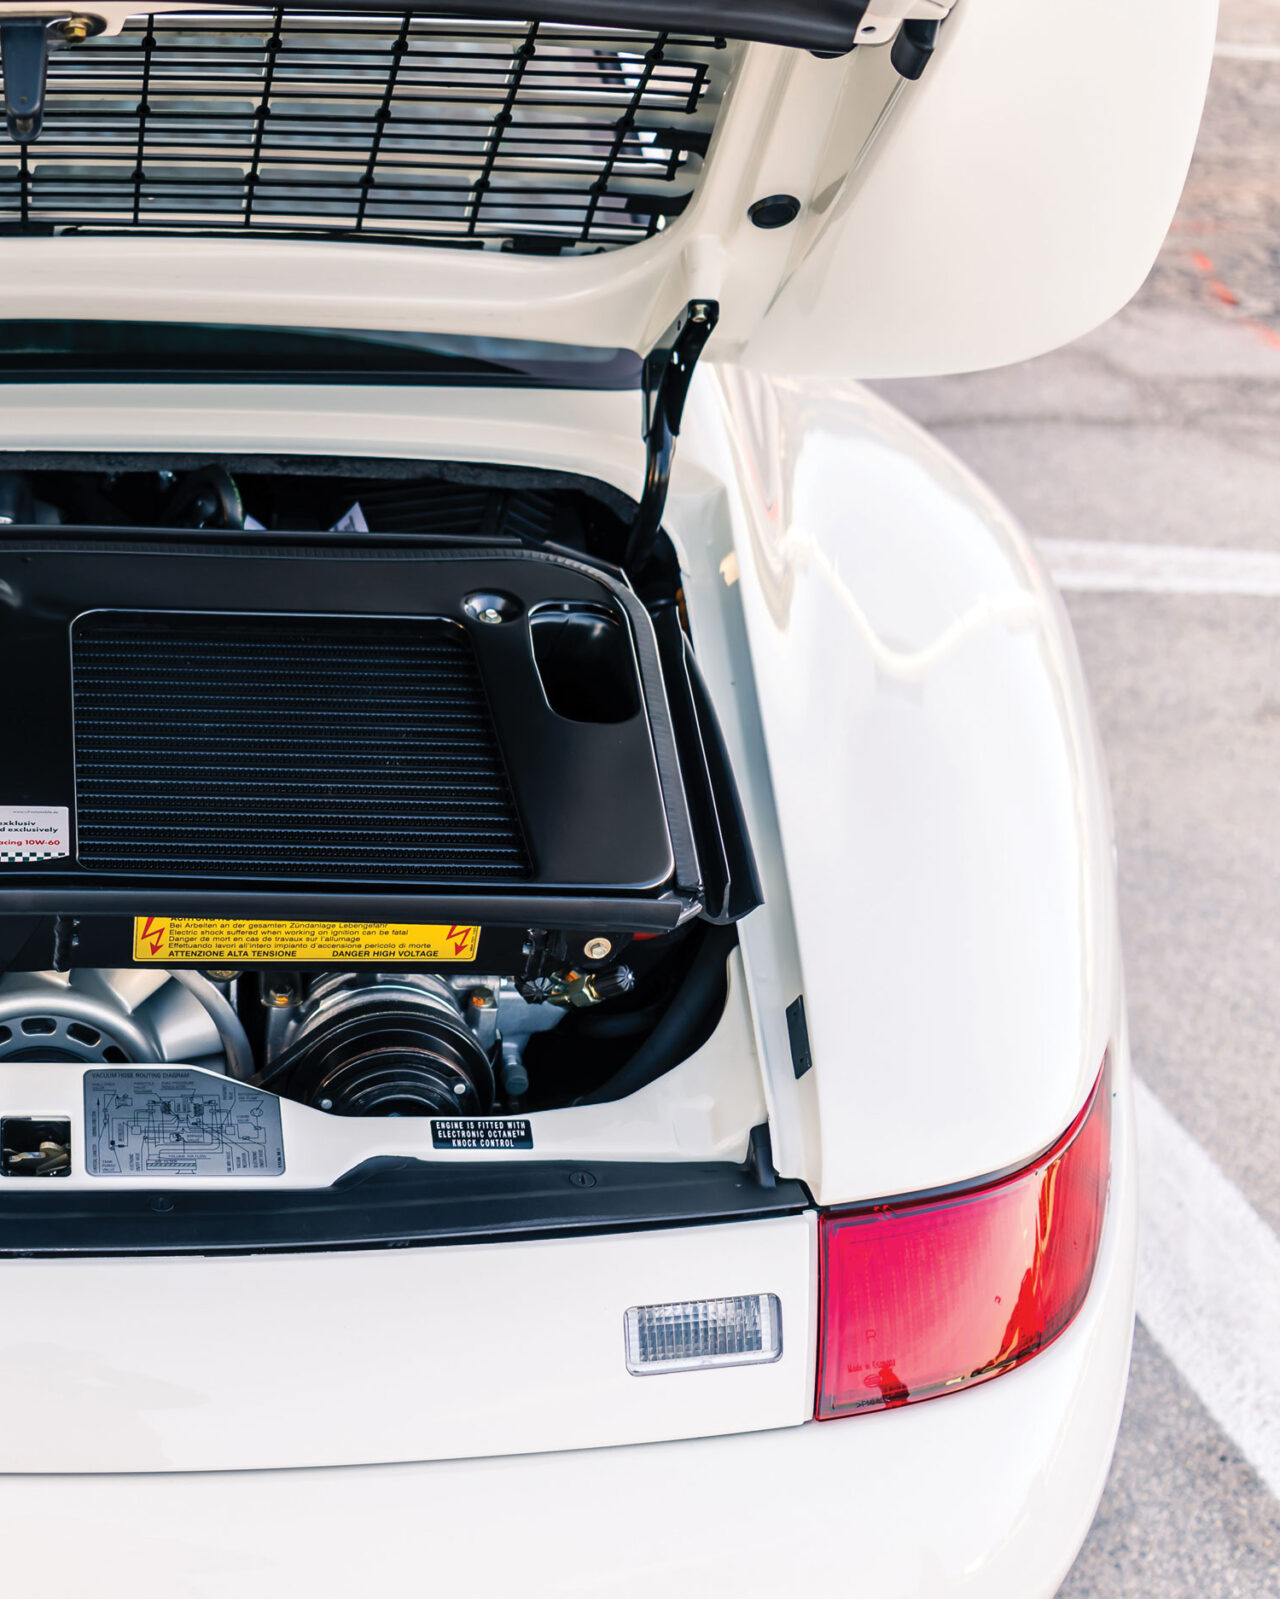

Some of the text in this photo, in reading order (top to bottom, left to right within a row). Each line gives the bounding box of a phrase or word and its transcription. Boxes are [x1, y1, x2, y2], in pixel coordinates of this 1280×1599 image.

[438, 1130, 484, 1138] ELECTRONIC
[452, 1139, 514, 1147] KNOCK CONTROL
